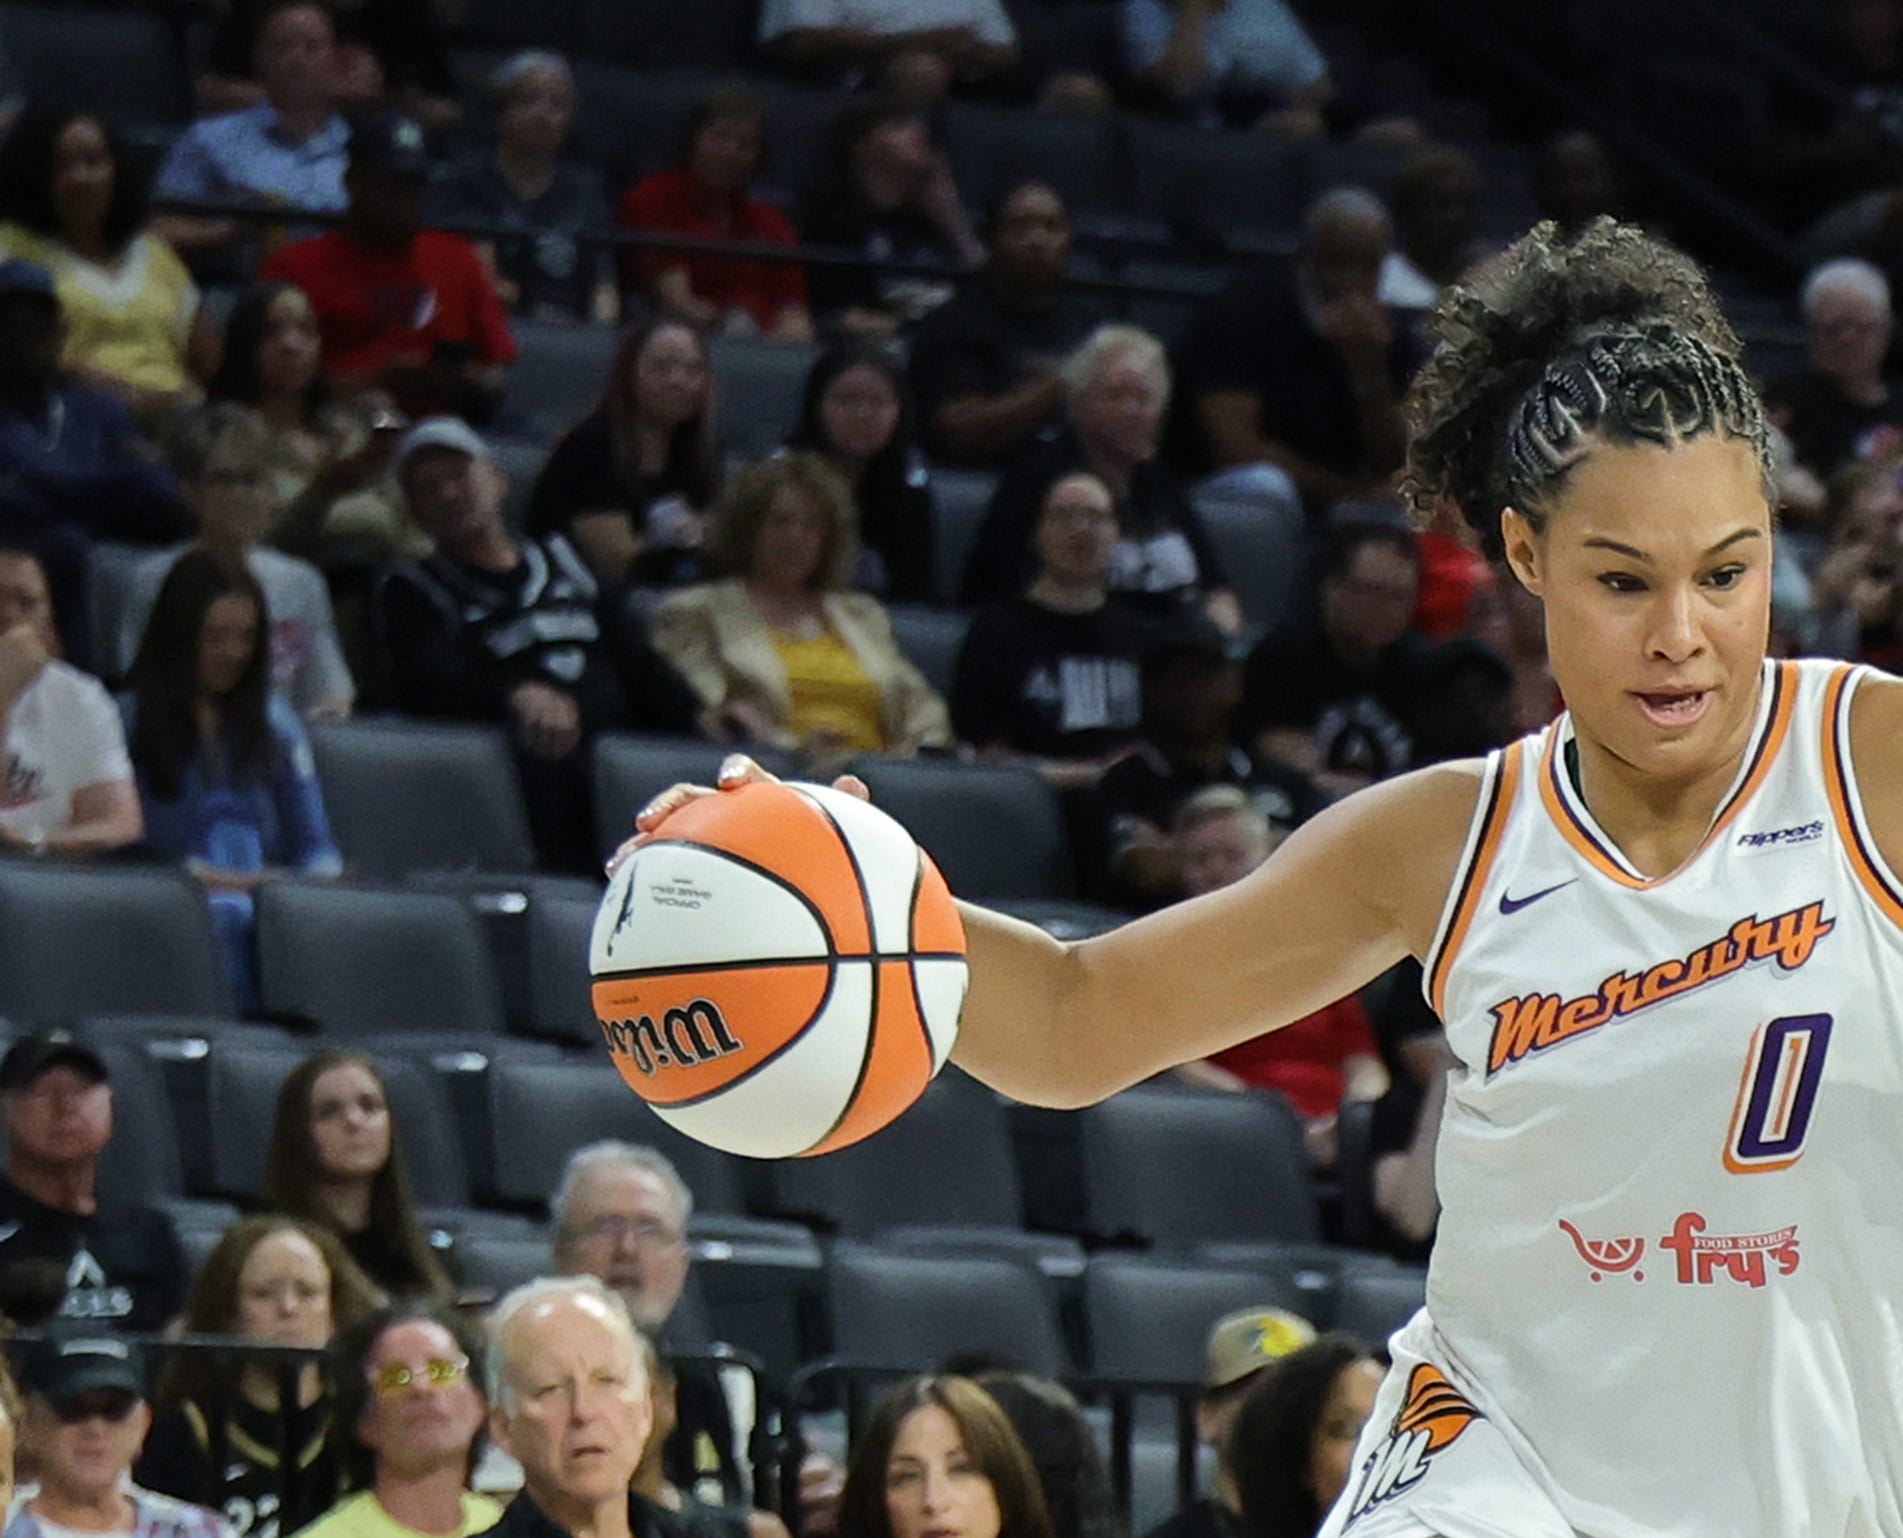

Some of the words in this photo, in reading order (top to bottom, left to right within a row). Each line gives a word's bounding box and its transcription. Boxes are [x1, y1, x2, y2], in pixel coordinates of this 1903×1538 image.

[1485, 899, 1837, 1085] Mercury
[1722, 1012, 1835, 1175] 0
[1659, 1211, 1801, 1288] fry's
[1693, 1235, 1733, 1250] FOOD
[1736, 1228, 1795, 1249] STORES
